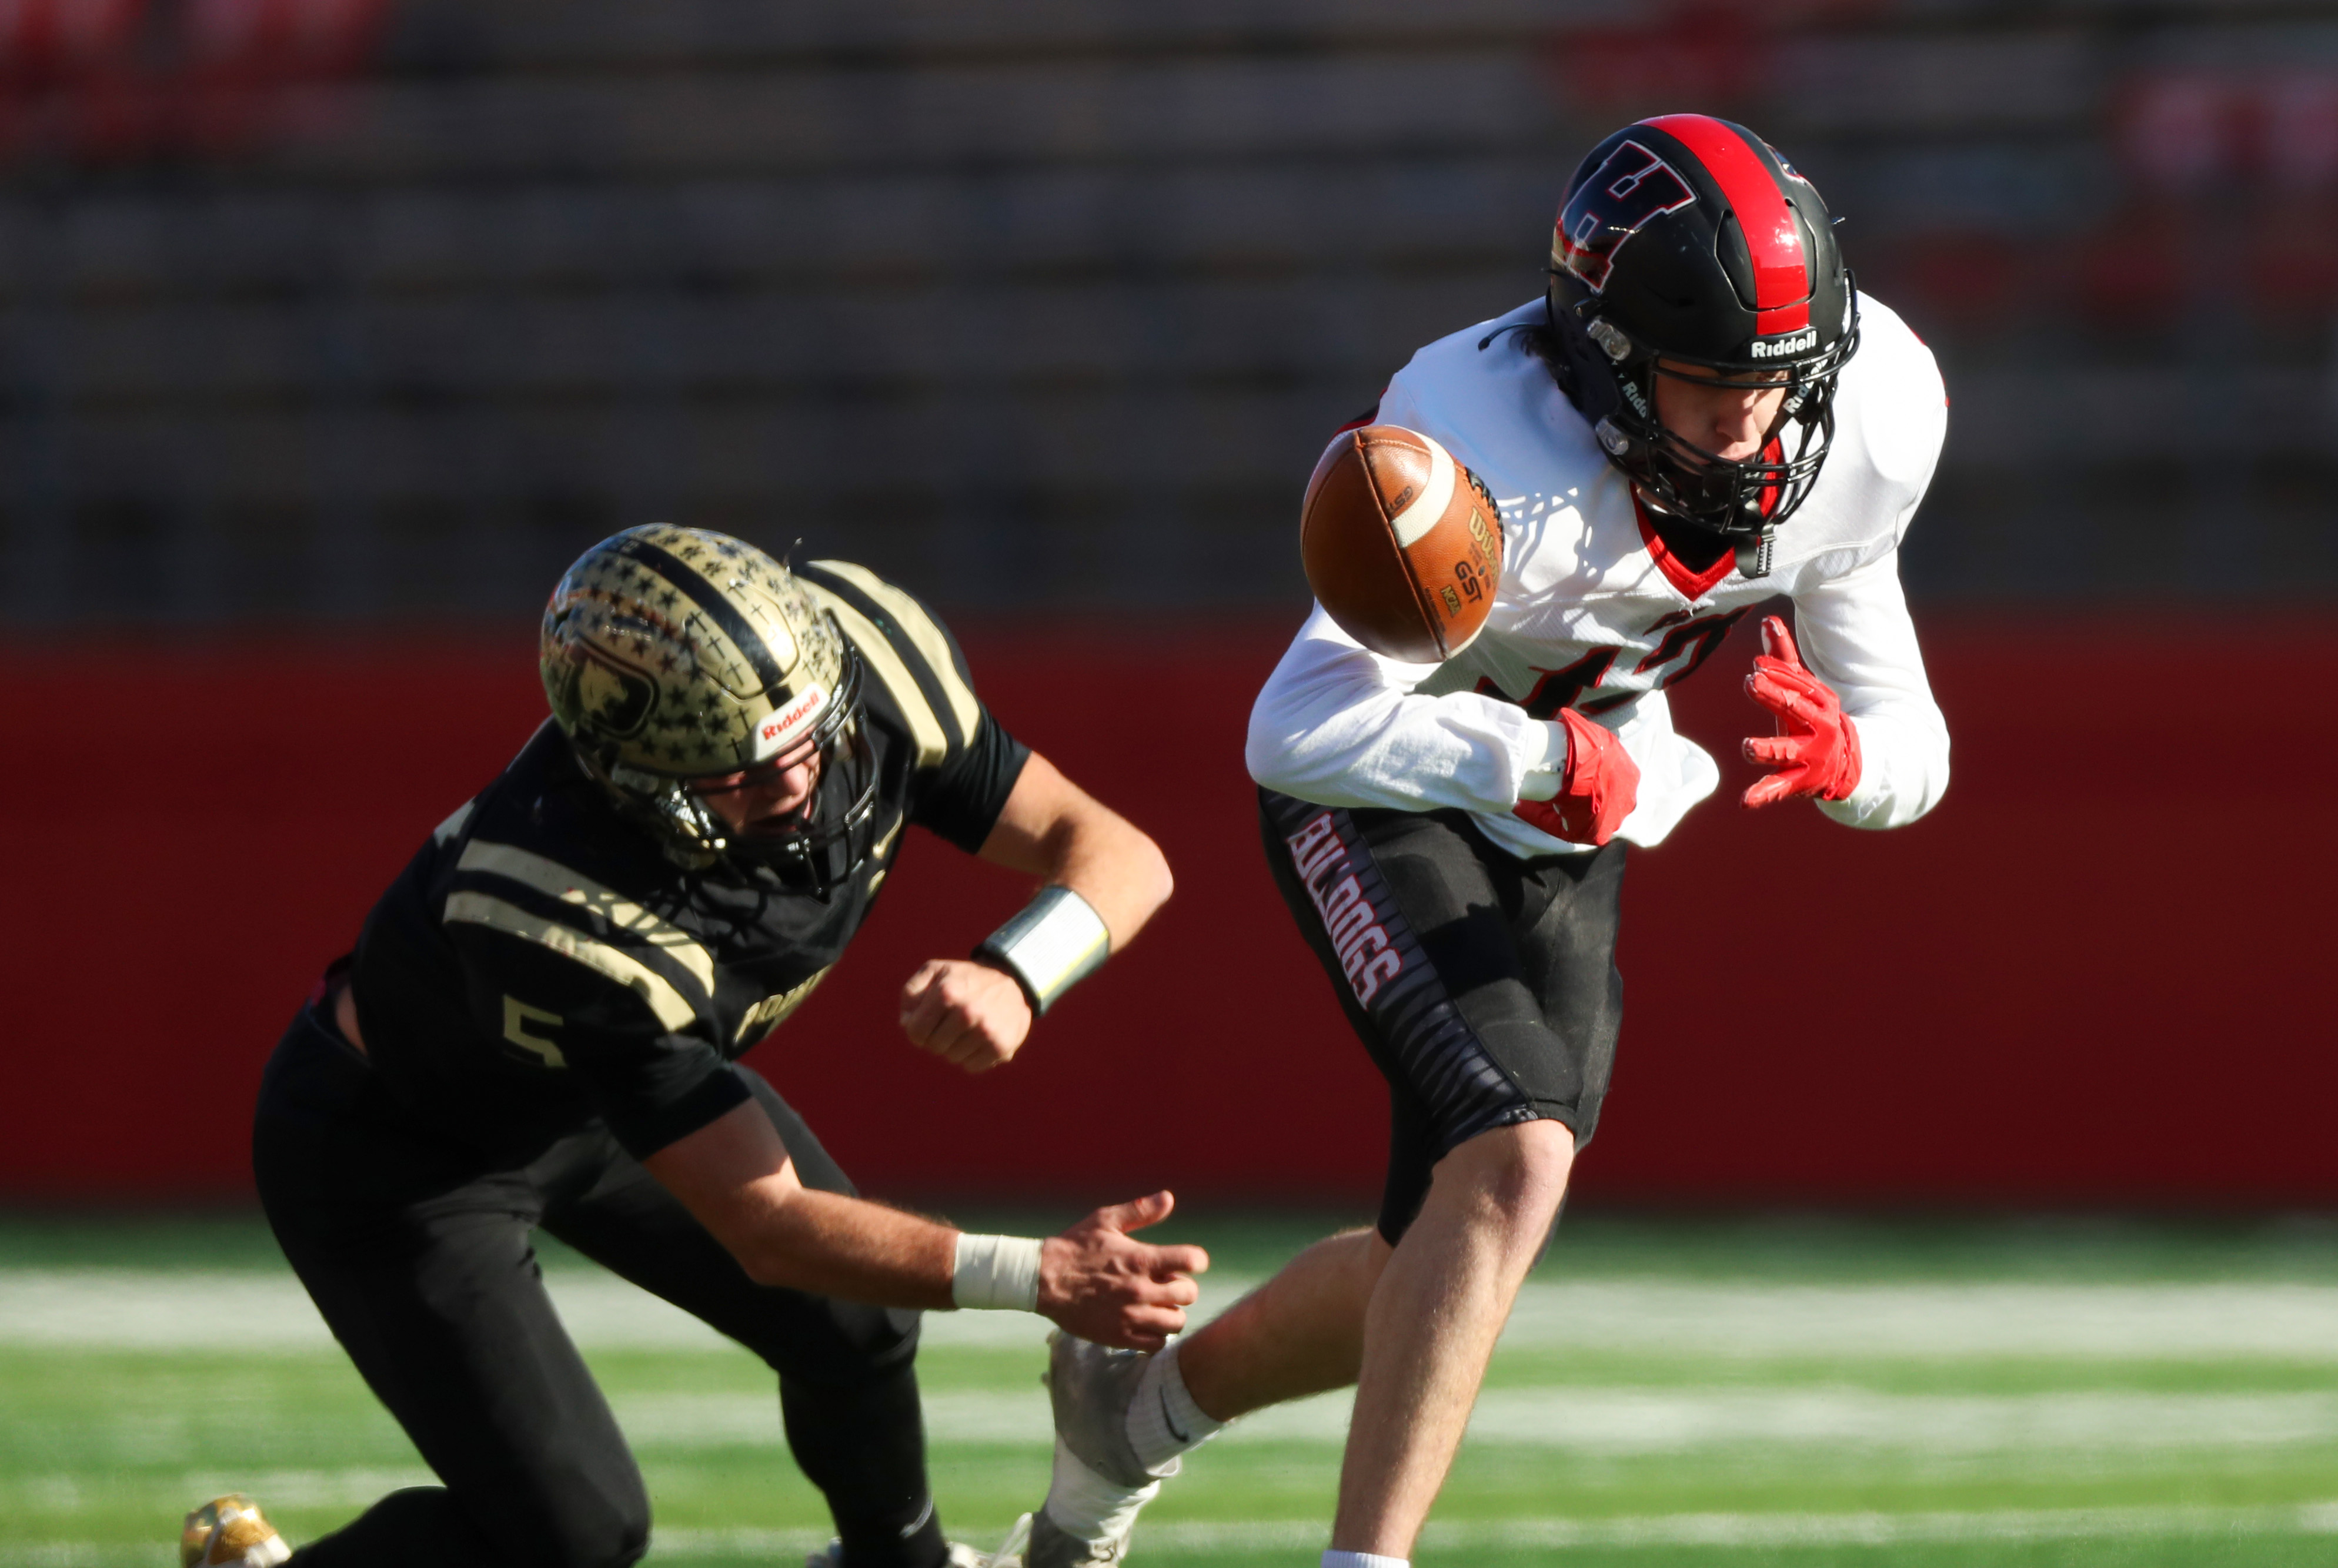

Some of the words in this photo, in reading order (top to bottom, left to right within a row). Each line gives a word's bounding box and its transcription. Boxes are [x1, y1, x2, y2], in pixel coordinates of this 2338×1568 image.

[1751, 330, 1817, 358] Riddell
[1455, 561, 1482, 603] GST
[762, 691, 819, 740] Riddell
[503, 993, 568, 1068] 5
